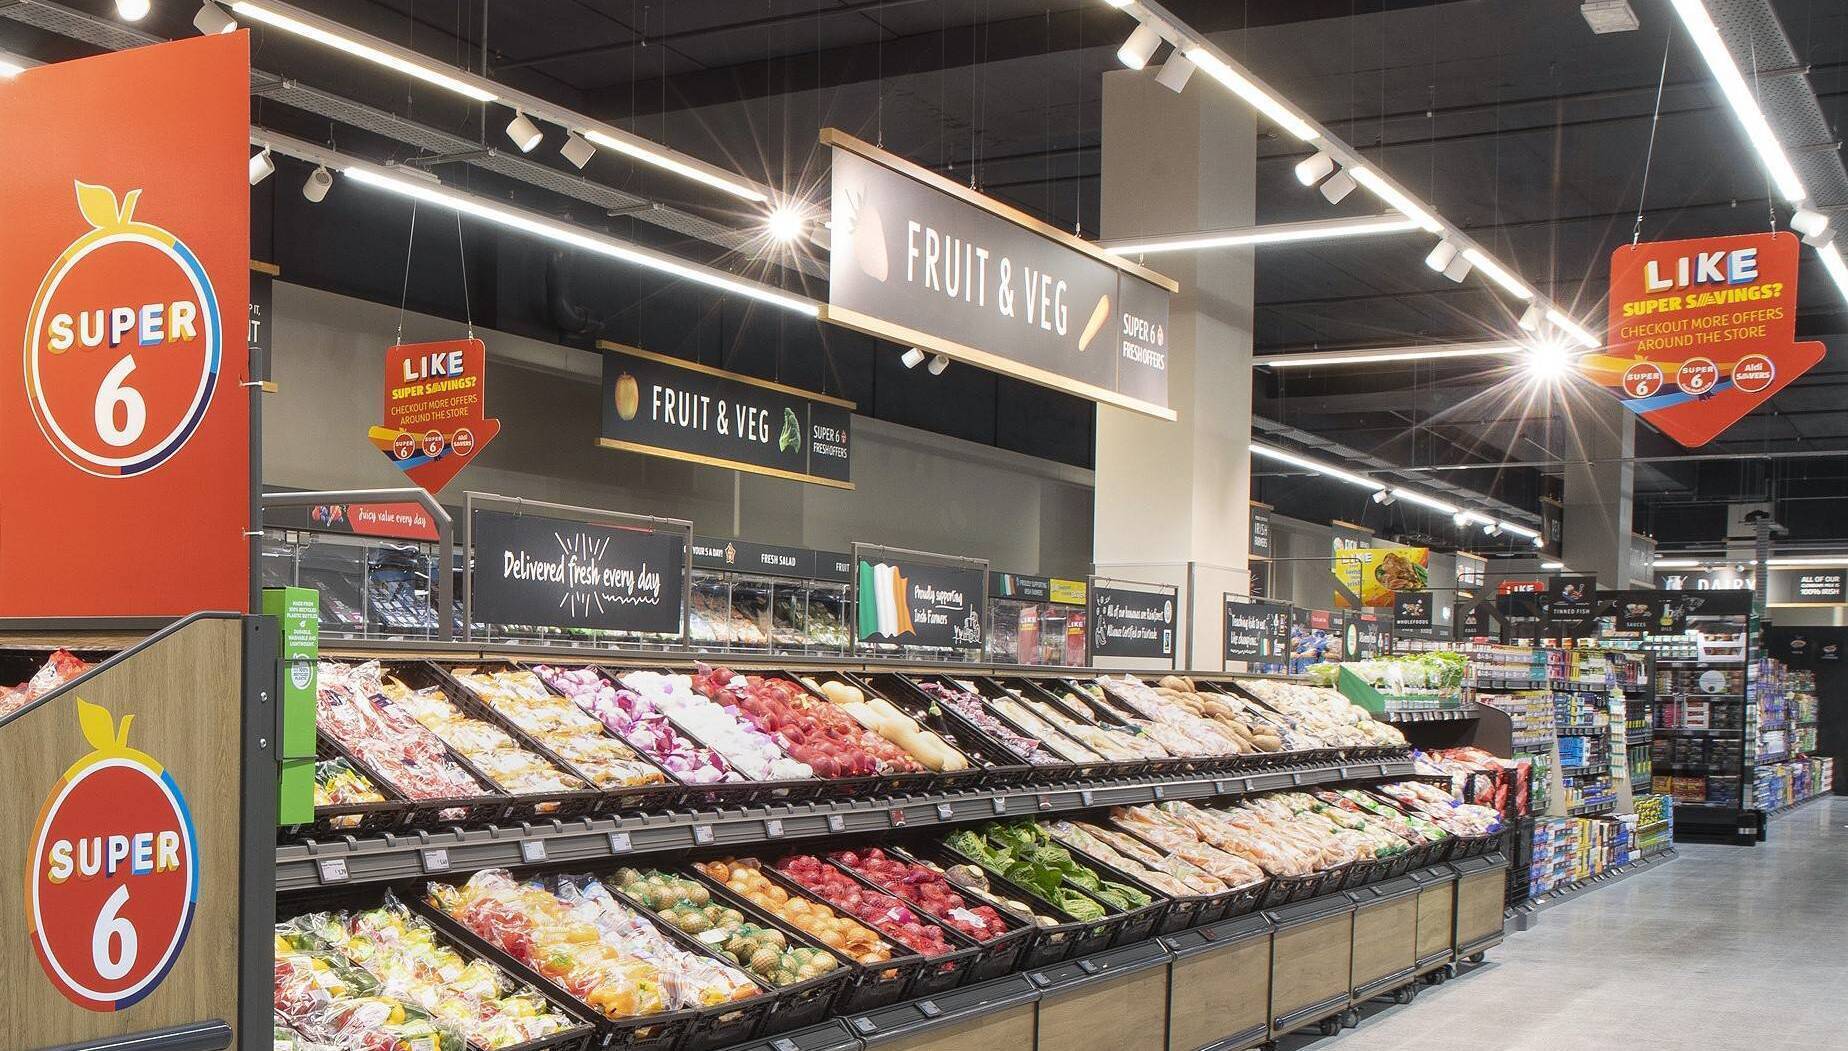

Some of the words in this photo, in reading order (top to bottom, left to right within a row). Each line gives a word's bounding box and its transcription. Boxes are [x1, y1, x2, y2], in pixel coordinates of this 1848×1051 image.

[908, 221, 989, 306] FRUIT
[999, 257, 1015, 317] &
[1025, 267, 1068, 336] VEG
[1645, 248, 1758, 294] LIKE
[1623, 297, 1682, 318] SUPER
[1686, 283, 1783, 309] SAVINGS?
[48, 301, 197, 354] SUPER
[1123, 313, 1149, 341] SUPER
[1150, 325, 1155, 345] 6
[1621, 319, 1689, 340] CHECKOUT
[1692, 314, 1730, 329] MORE
[1732, 307, 1784, 324] OFFERS
[1637, 335, 1693, 352] AROUND
[1696, 332, 1723, 345] THE
[1725, 325, 1767, 341] STORE
[404, 351, 464, 382] LIKE
[1627, 372, 1660, 381] SUPER
[392, 385, 424, 400] SUPER
[426, 377, 477, 394] SAVINGS?
[1636, 381, 1648, 395] 6
[1691, 374, 1703, 388] 6
[95, 353, 147, 447] 6
[392, 401, 427, 416] CHECKOUT
[429, 399, 449, 409] MORE
[450, 394, 478, 407] OFFERS
[401, 414, 430, 425] AROUND
[432, 411, 445, 420] THE
[446, 407, 468, 418] STORE
[652, 385, 710, 431] FRUIT
[717, 400, 729, 435] &
[736, 404, 769, 443] VEG
[814, 425, 834, 443] SUPER
[836, 431, 840, 443] 6
[401, 447, 408, 458] 6
[430, 442, 436, 453] 6
[359, 508, 376, 522] Juicy
[378, 509, 395, 522] value
[396, 515, 413, 526] every
[414, 513, 426, 528] day
[761, 554, 778, 565] FRESH
[780, 555, 796, 567] SALAD
[836, 563, 850, 572] FRUIT
[504, 550, 564, 584] Delivered
[568, 554, 600, 588] fresh
[604, 568, 634, 595] every
[638, 563, 661, 597] day
[1698, 579, 1755, 590] DARY
[915, 584, 935, 604] Proudly
[936, 590, 963, 607] supporting
[914, 609, 927, 623] Irish
[48, 831, 180, 884] SUPER
[92, 884, 138, 980] 6
